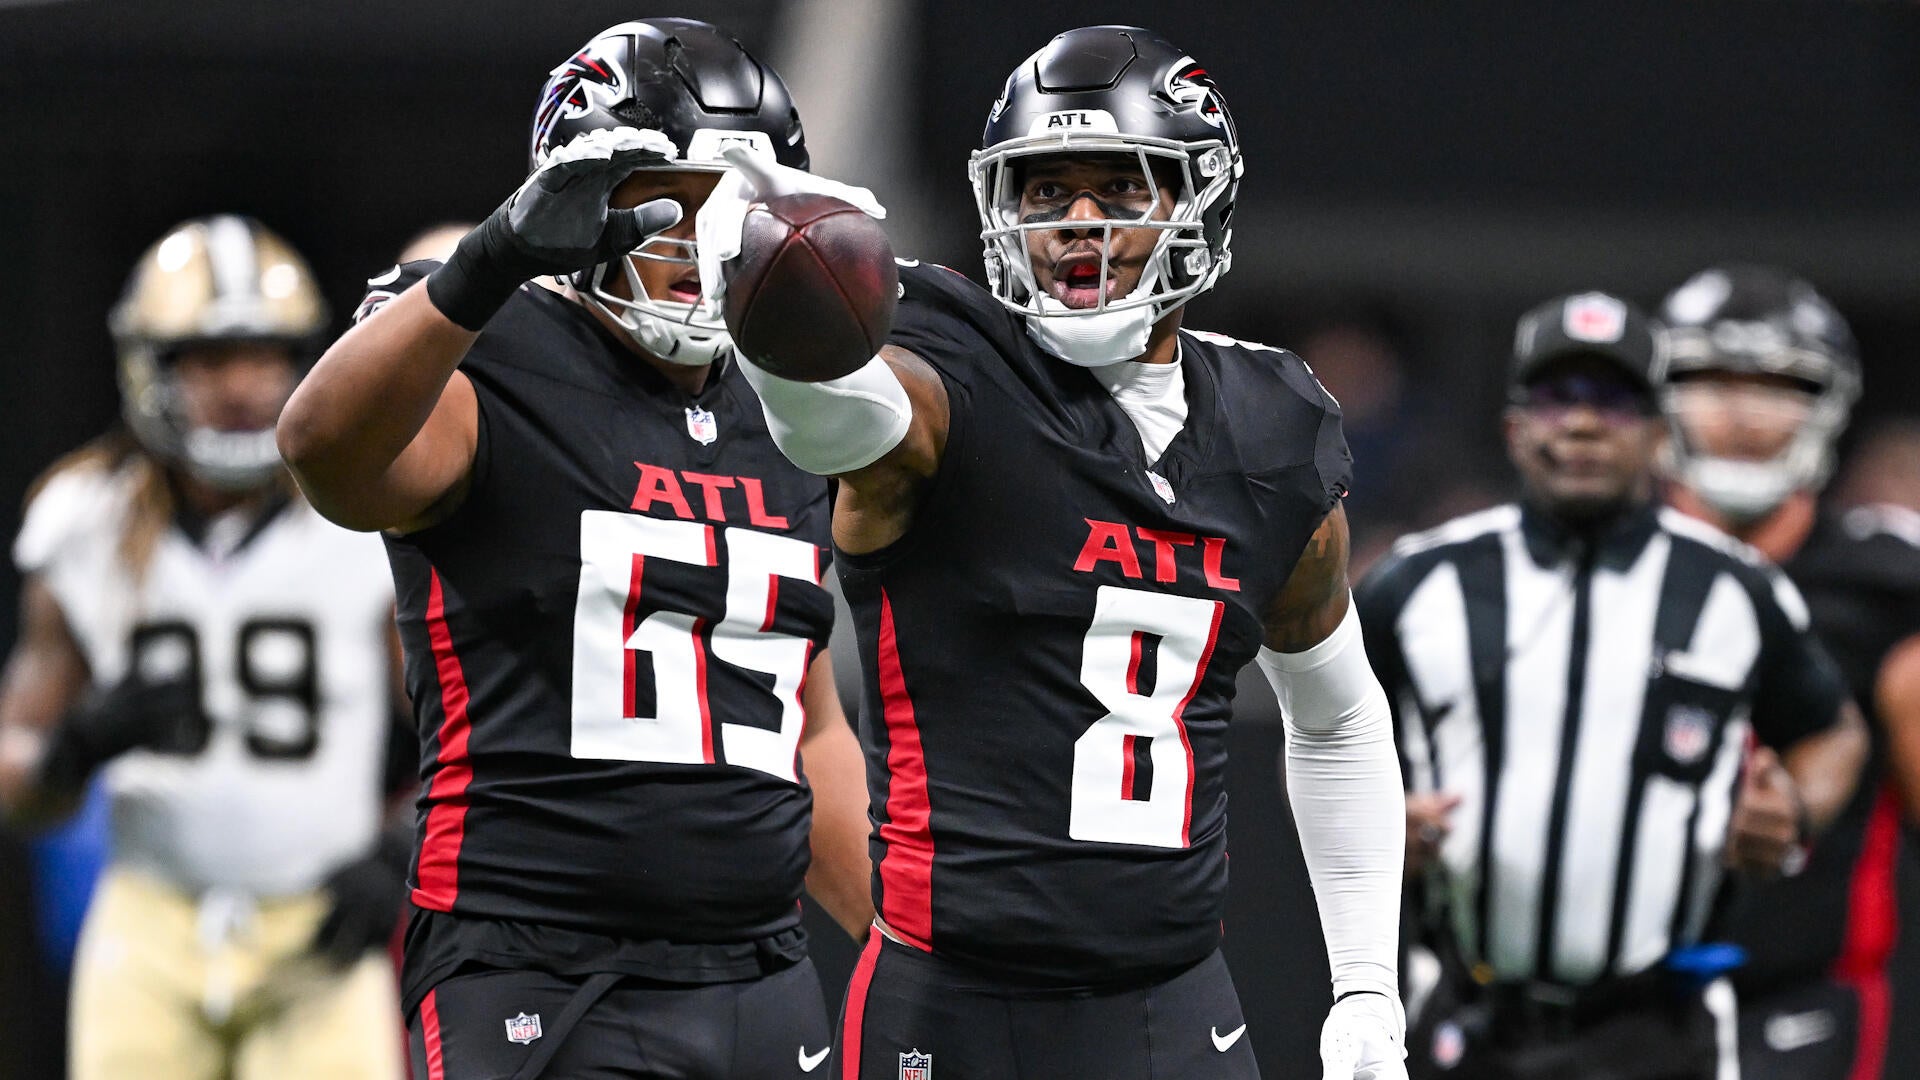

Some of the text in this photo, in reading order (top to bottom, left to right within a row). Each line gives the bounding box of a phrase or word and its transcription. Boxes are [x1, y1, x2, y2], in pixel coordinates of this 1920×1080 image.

[1048, 113, 1091, 128] ATL
[630, 461, 789, 529] ATL
[1072, 518, 1241, 592] ATL
[570, 509, 822, 784] 65
[1069, 585, 1225, 848] 8
[513, 1025, 538, 1038] NFL
